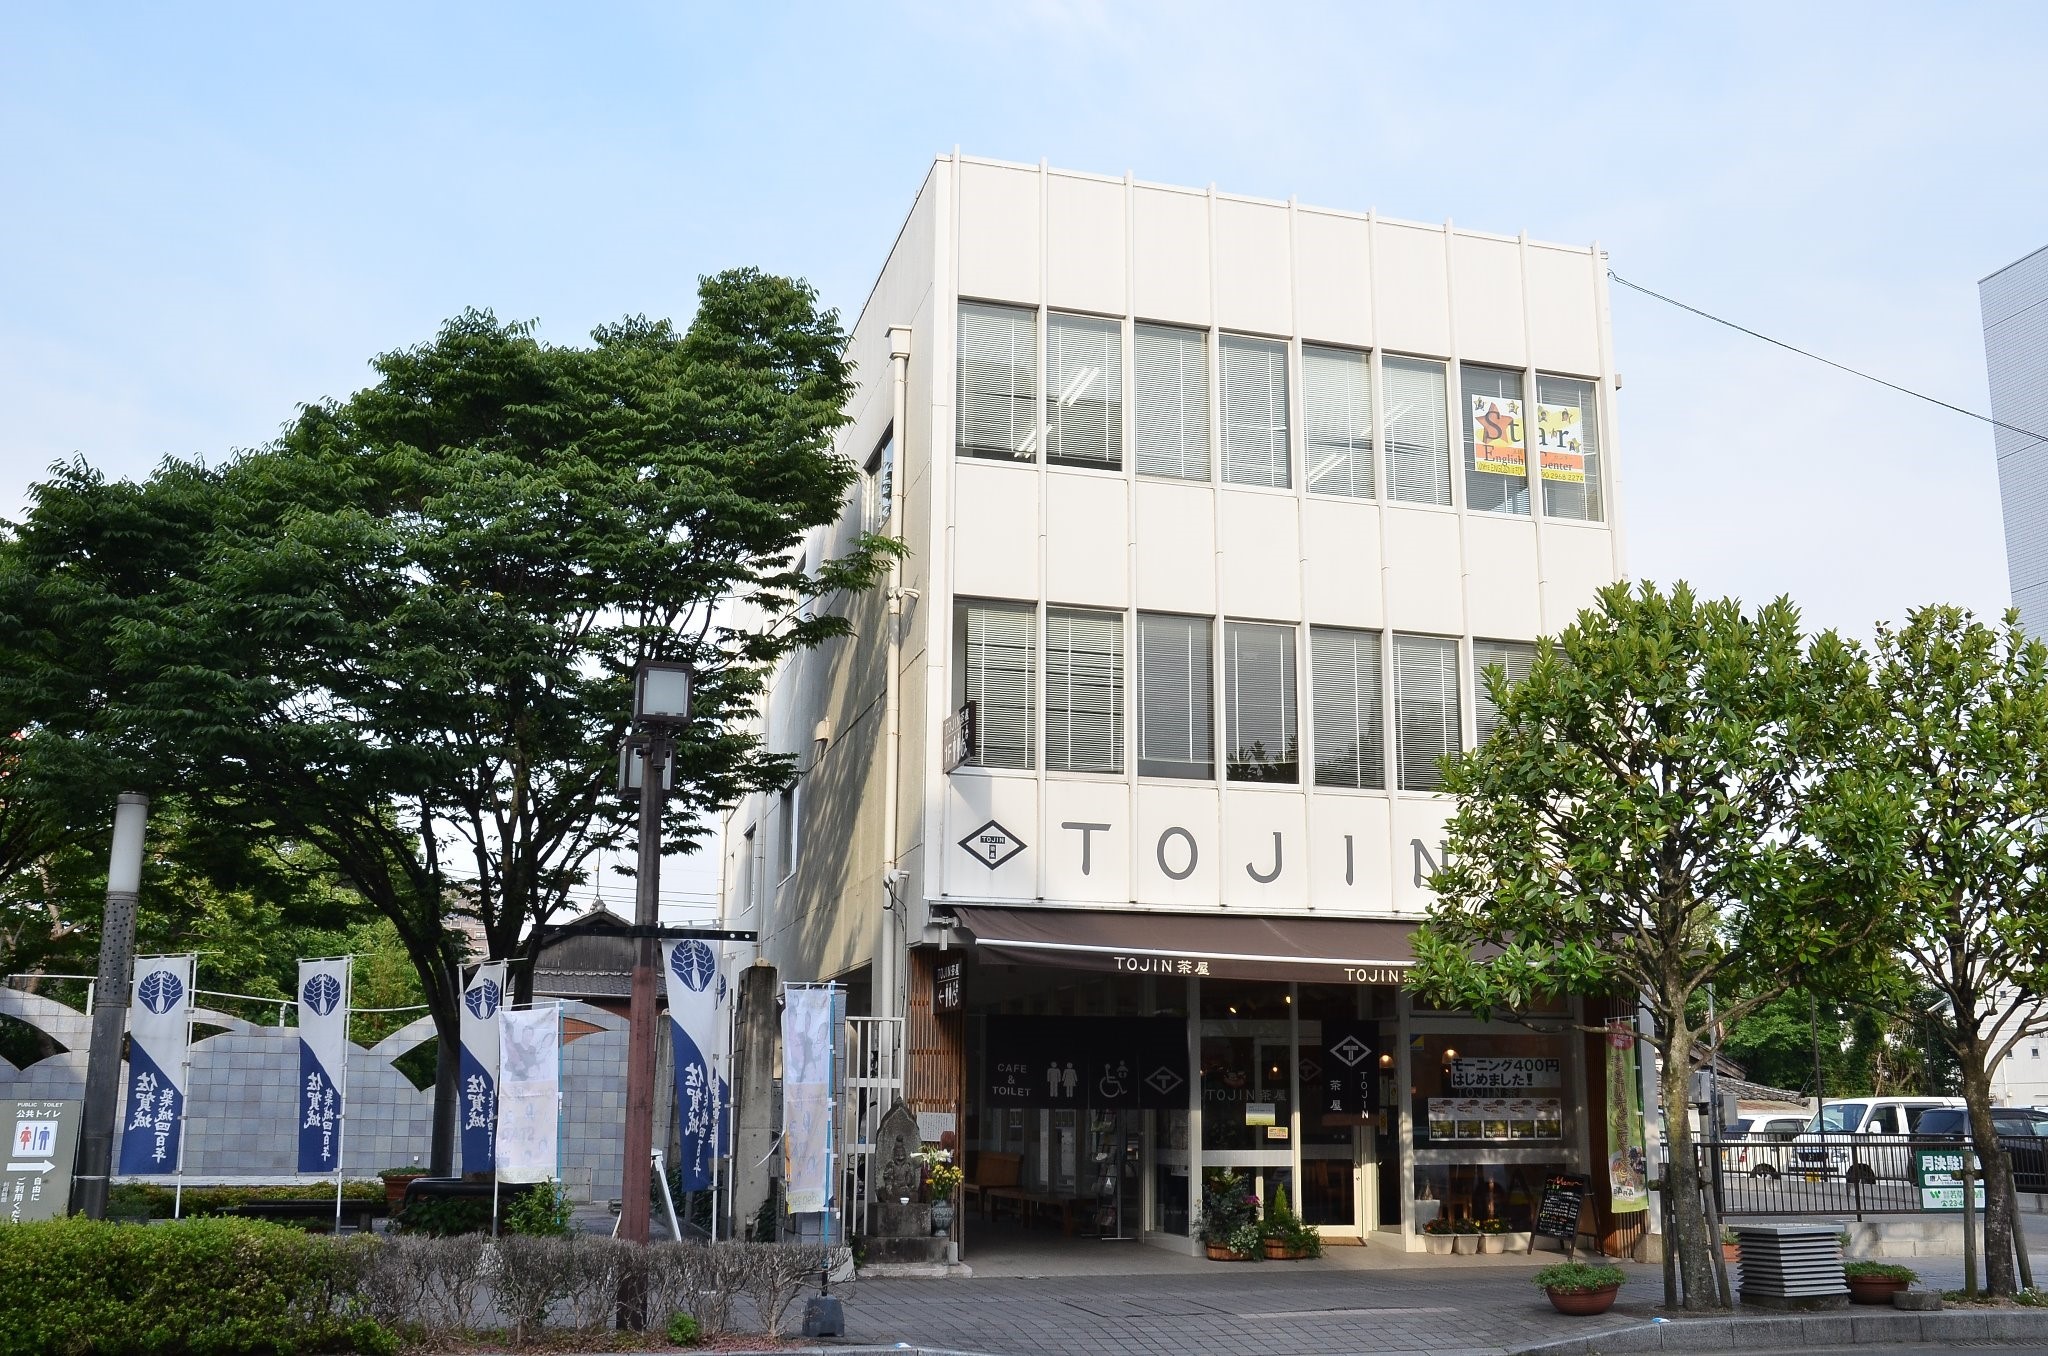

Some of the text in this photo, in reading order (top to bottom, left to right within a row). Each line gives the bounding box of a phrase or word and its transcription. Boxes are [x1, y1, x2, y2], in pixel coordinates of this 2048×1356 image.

[1483, 445, 1524, 466] English
[1540, 471, 1549, 479] 90
[981, 836, 1005, 844] TOJIN
[1061, 821, 1449, 889] TOJIN
[997, 1063, 1028, 1074] CAFE
[1452, 1058, 1560, 1073] モーニング400円
[1007, 1075, 1016, 1085] &
[992, 1086, 1032, 1097] TOILET
[1330, 1080, 1342, 1111] 茶屋
[1360, 1071, 1369, 1119] TOJIN
[16, 1109, 61, 1118] 公共トイレ
[30, 1176, 42, 1202] 自由に
